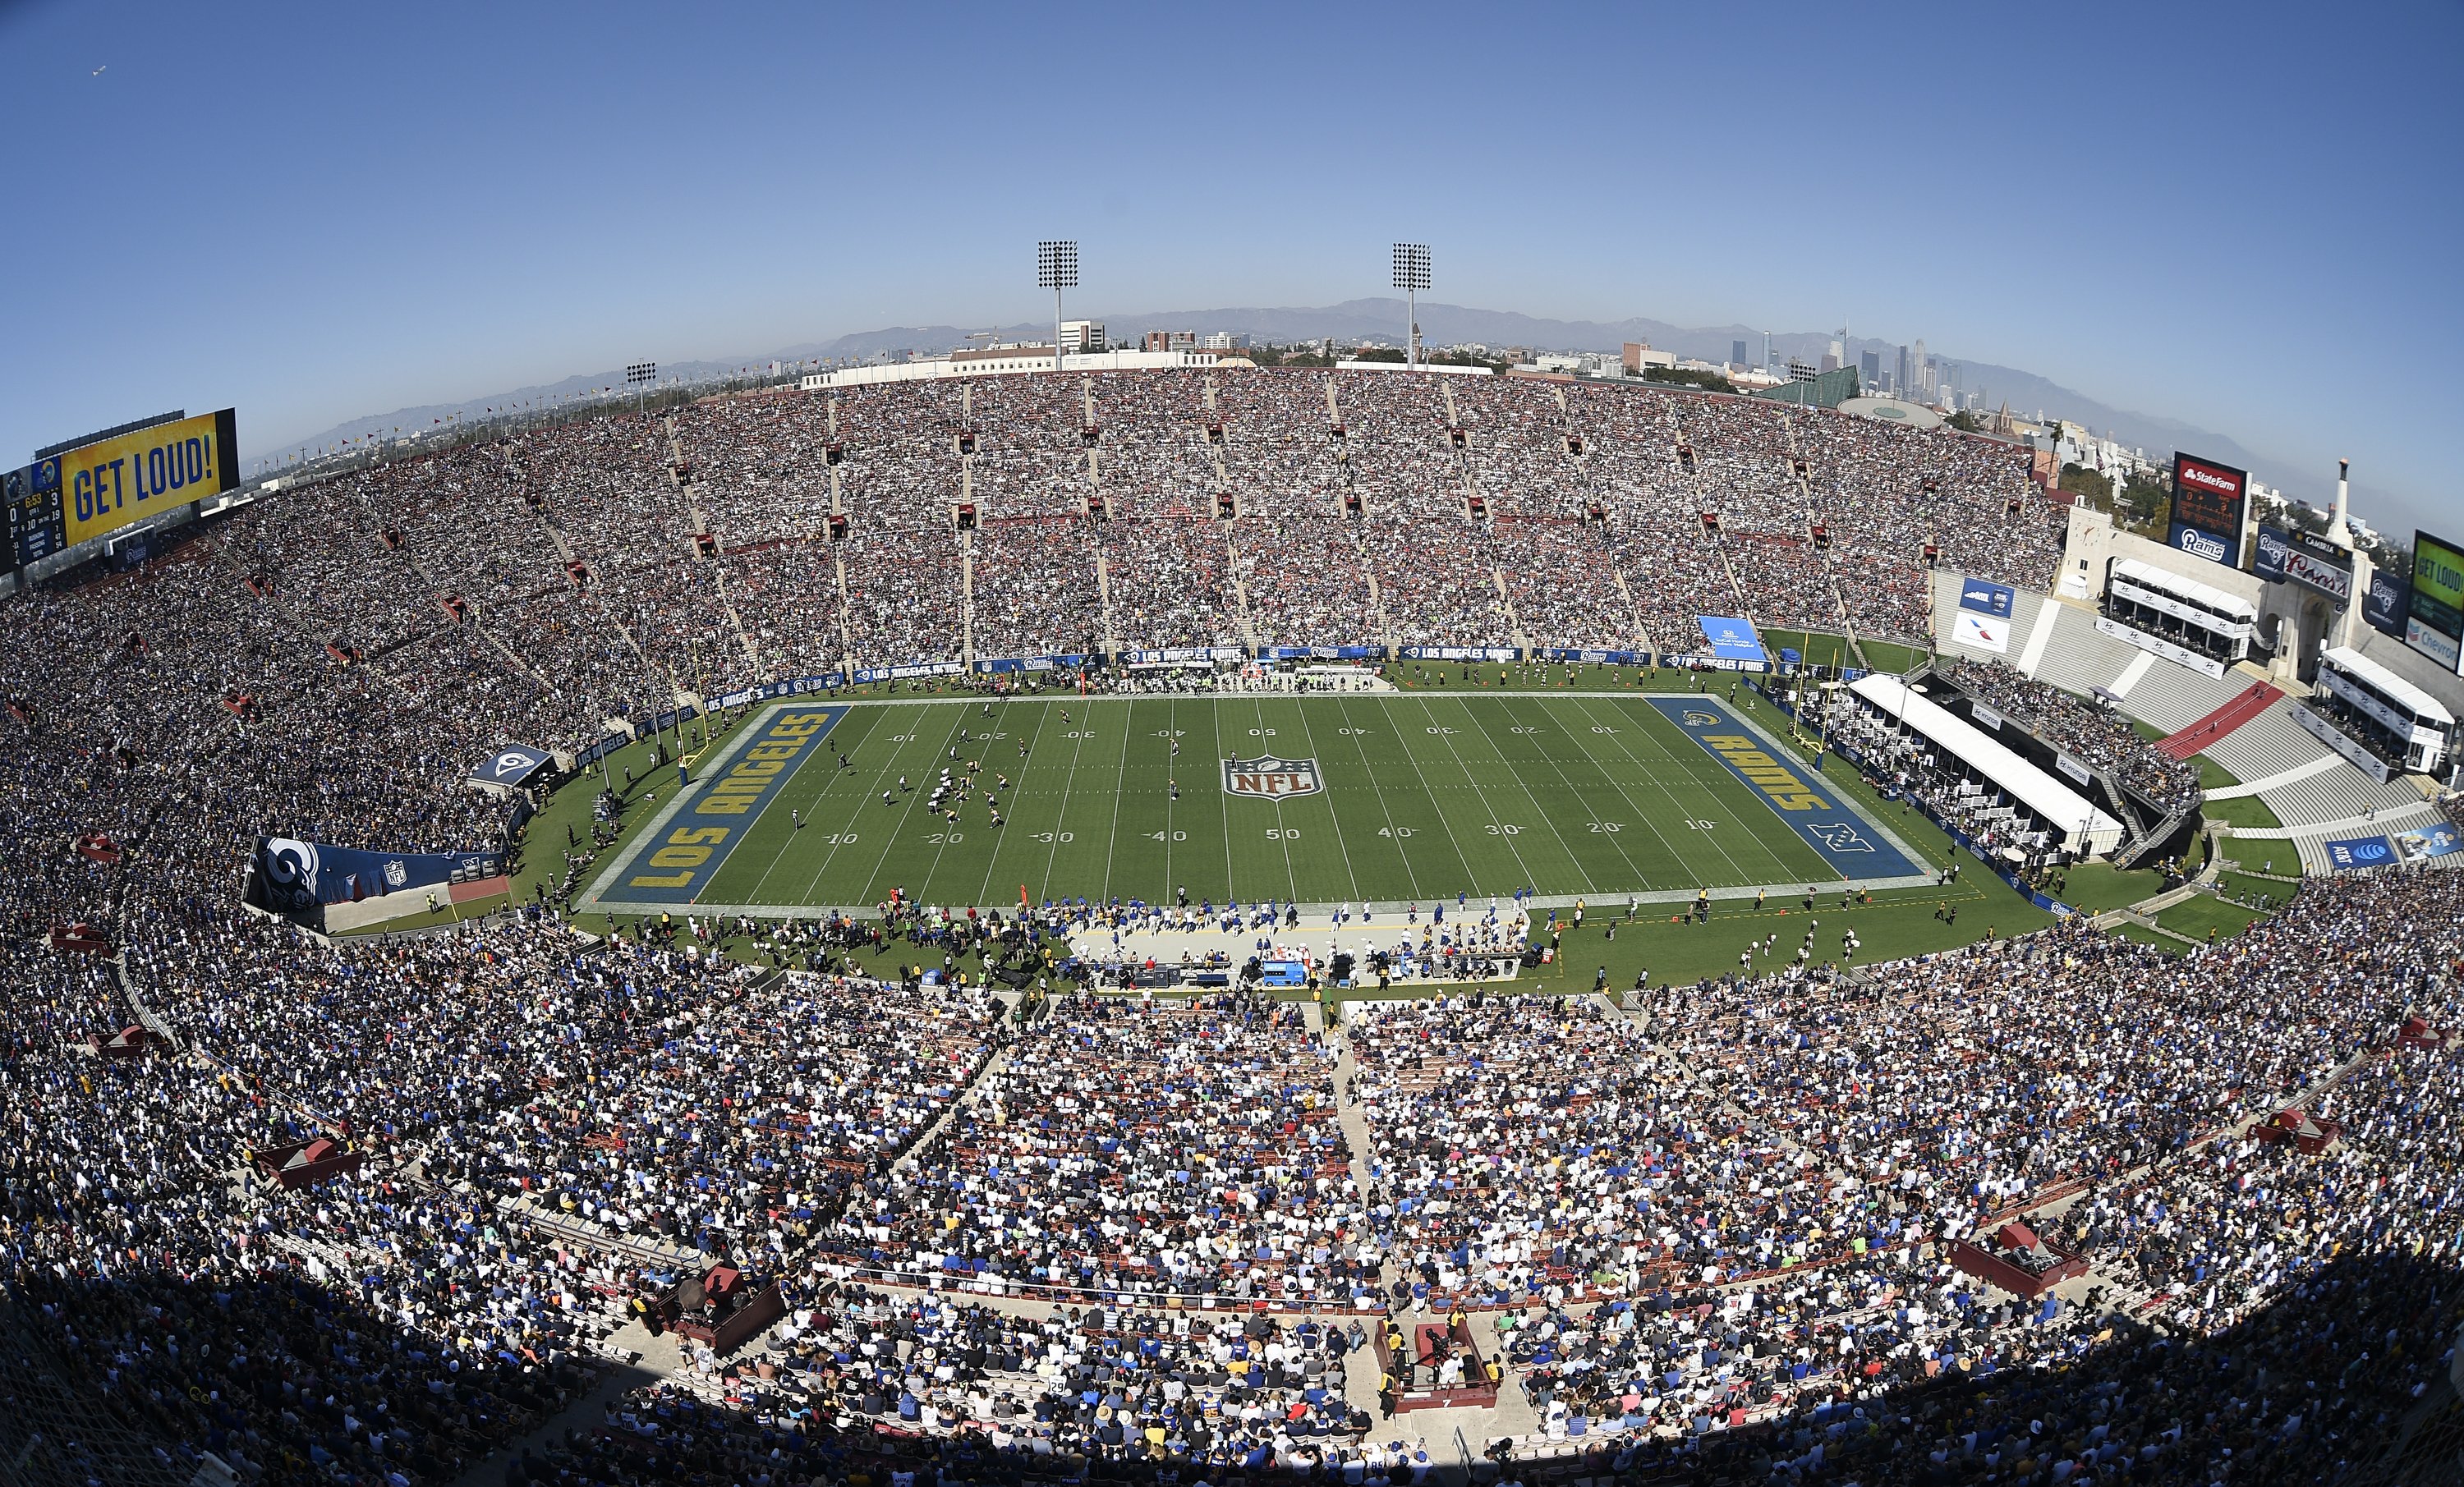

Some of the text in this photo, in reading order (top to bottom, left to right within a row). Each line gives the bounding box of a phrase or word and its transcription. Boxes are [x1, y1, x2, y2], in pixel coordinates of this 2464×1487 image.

[74, 434, 212, 522] GET LOUD!
[25, 493, 41, 507] 6:53
[51, 493, 58, 506] 3
[10, 507, 16, 522] 0
[27, 519, 35, 530] 10
[52, 510, 60, 521] 19
[2181, 528, 2225, 562] Rams
[2305, 536, 2334, 554] CAMBRIA
[2418, 557, 2464, 594] GET LOUD!
[2421, 631, 2457, 662] Chevron
[1142, 651, 1161, 662] LOS
[1211, 649, 1242, 660] RAMS
[1422, 647, 1439, 659] LOS
[1441, 647, 1483, 659] ANGELES
[872, 669, 889, 680] LOS
[703, 698, 720, 711] LOS
[1981, 713, 1998, 726] HYUNDAI
[577, 750, 591, 767] LOS
[1700, 735, 1832, 810] RAMS
[2066, 764, 2086, 781] HYUNDAI
[1234, 774, 1312, 793] NFL
[629, 713, 830, 888] LOS ANGELES
[1484, 824, 1519, 836] 30
[1586, 822, 1620, 833] 20
[1685, 819, 1714, 830] 10
[1038, 832, 1074, 842] 30
[1152, 831, 1187, 842] 40
[1266, 828, 1301, 839] 50
[1377, 826, 1412, 838] 40
[828, 833, 858, 844] 10
[928, 833, 964, 844] 20
[2333, 846, 2353, 864] AT&T
[2051, 902, 2071, 918] Ram
[1952, 1243, 1959, 1251] 6
[2060, 1274, 2067, 1282] 6
[1790, 1315, 1798, 1323] 30
[1002, 1335, 1011, 1344] 30
[923, 1365, 934, 1373] 30
[1051, 1383, 1064, 1393] 29
[1442, 1399, 1452, 1407] 7
[1203, 1408, 1218, 1417] 85
